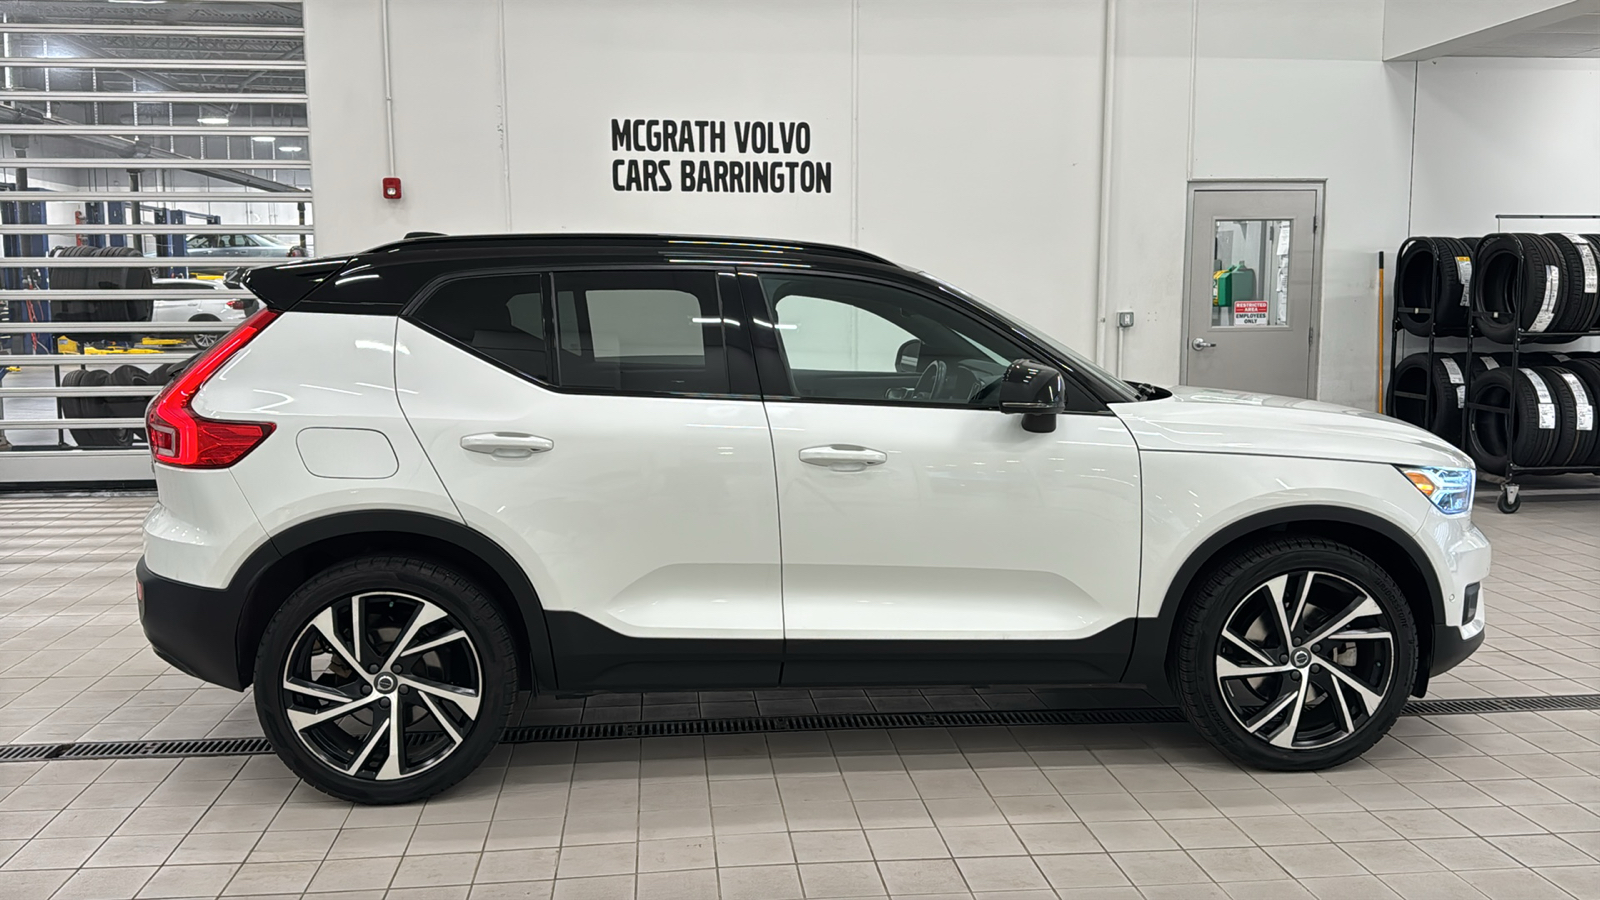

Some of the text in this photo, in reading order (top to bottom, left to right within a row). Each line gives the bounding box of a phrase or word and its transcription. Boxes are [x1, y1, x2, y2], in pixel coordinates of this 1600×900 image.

[611, 118, 811, 154] MCGRATH VOLVO
[612, 159, 832, 194] CARS BARRINGTON
